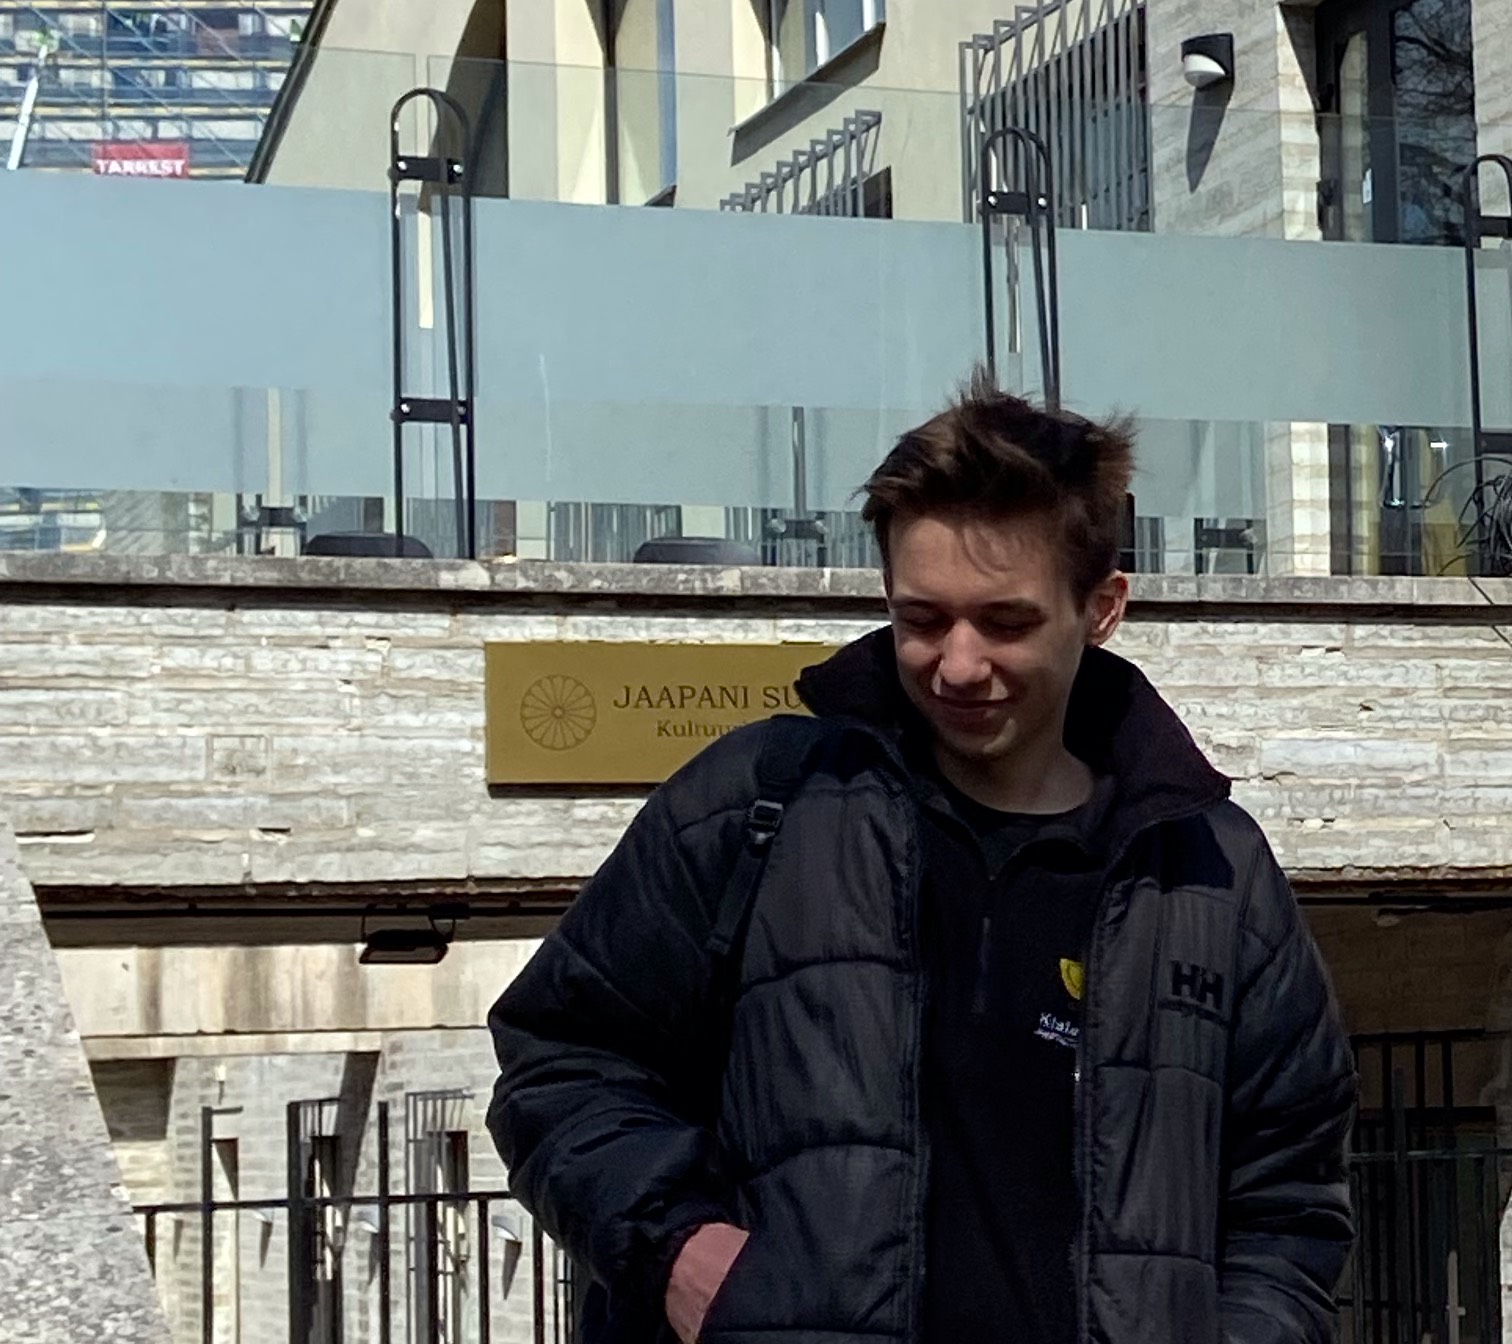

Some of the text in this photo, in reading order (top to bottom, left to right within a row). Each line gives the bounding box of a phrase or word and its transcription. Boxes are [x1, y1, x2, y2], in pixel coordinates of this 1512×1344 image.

[96, 159, 185, 177] TARREST
[613, 685, 749, 709] JAAPANI
[1171, 960, 1224, 1009] HH
